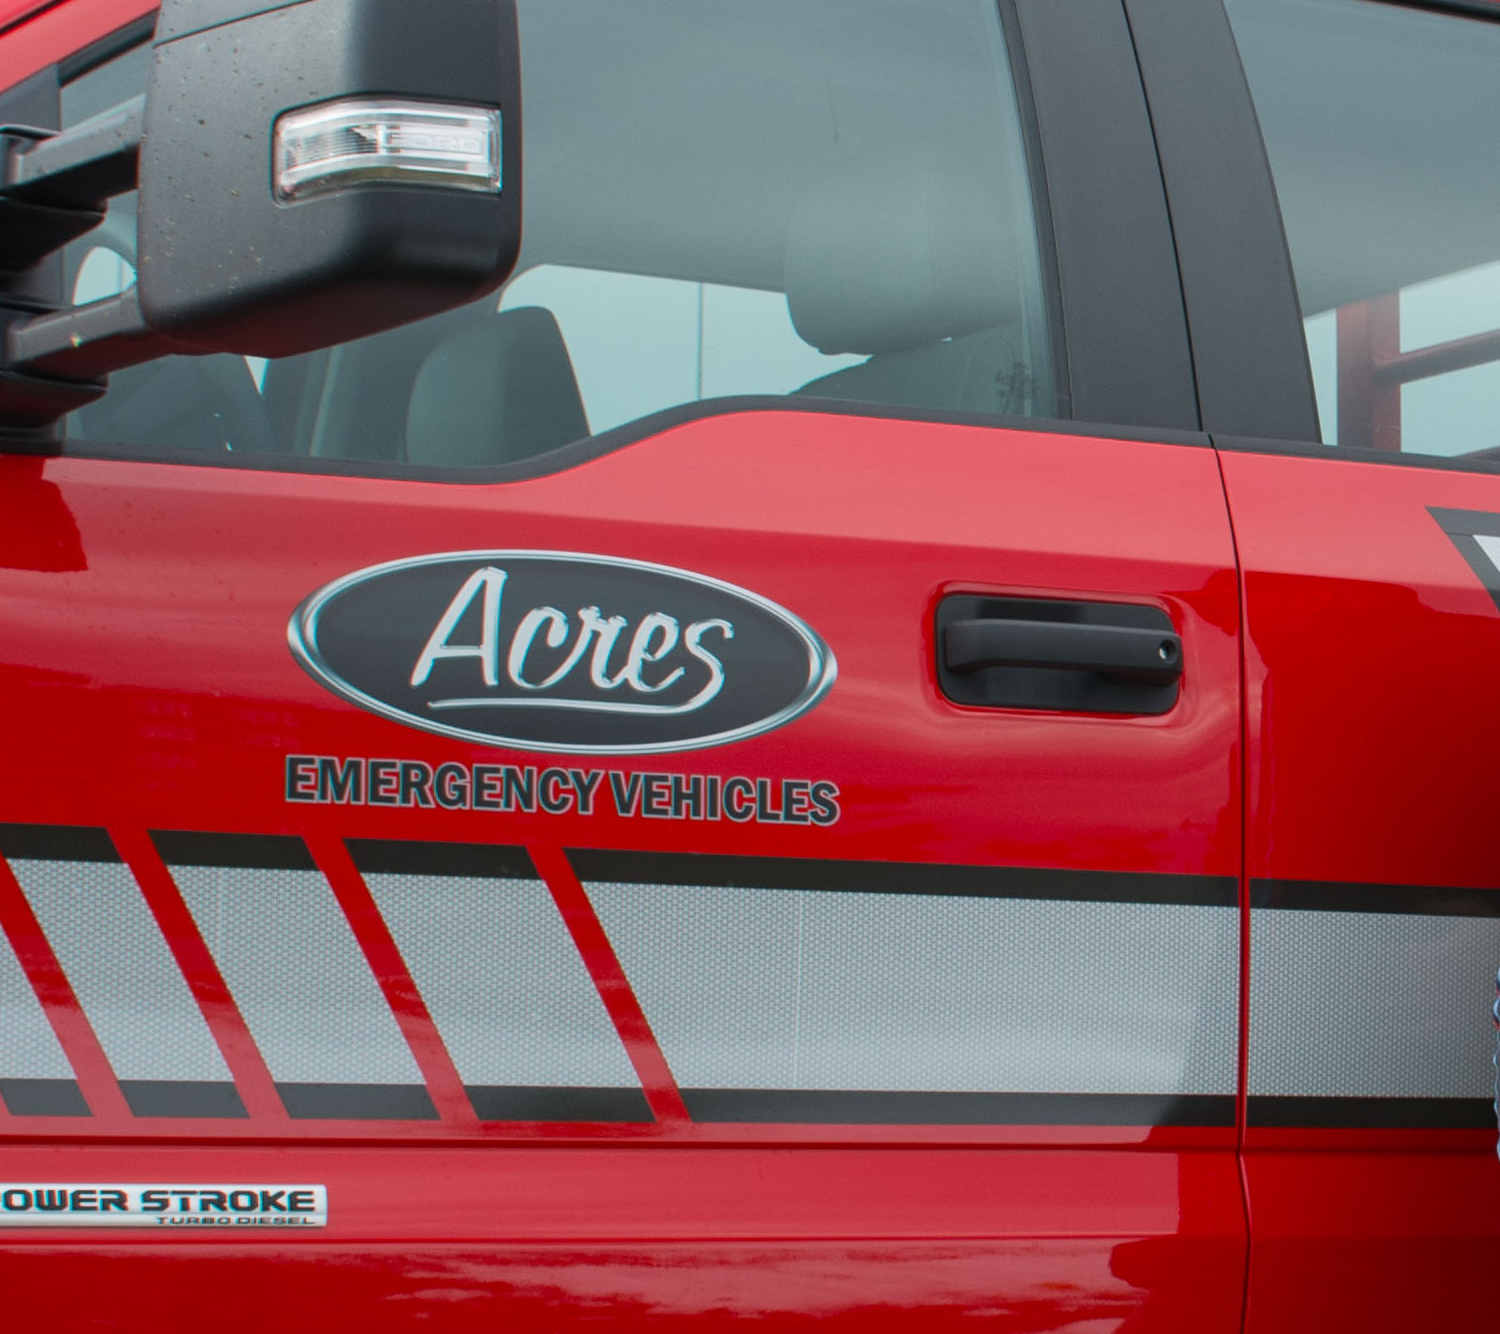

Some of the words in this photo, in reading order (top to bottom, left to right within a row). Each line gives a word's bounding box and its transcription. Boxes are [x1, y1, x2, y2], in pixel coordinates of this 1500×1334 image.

[409, 565, 735, 714] Acres
[284, 753, 606, 816] EMERGENCY
[608, 770, 841, 826] VEHICLES
[140, 1190, 316, 1212] STROKE
[156, 1216, 231, 1225] TURBO
[235, 1216, 315, 1225] DIESEL
